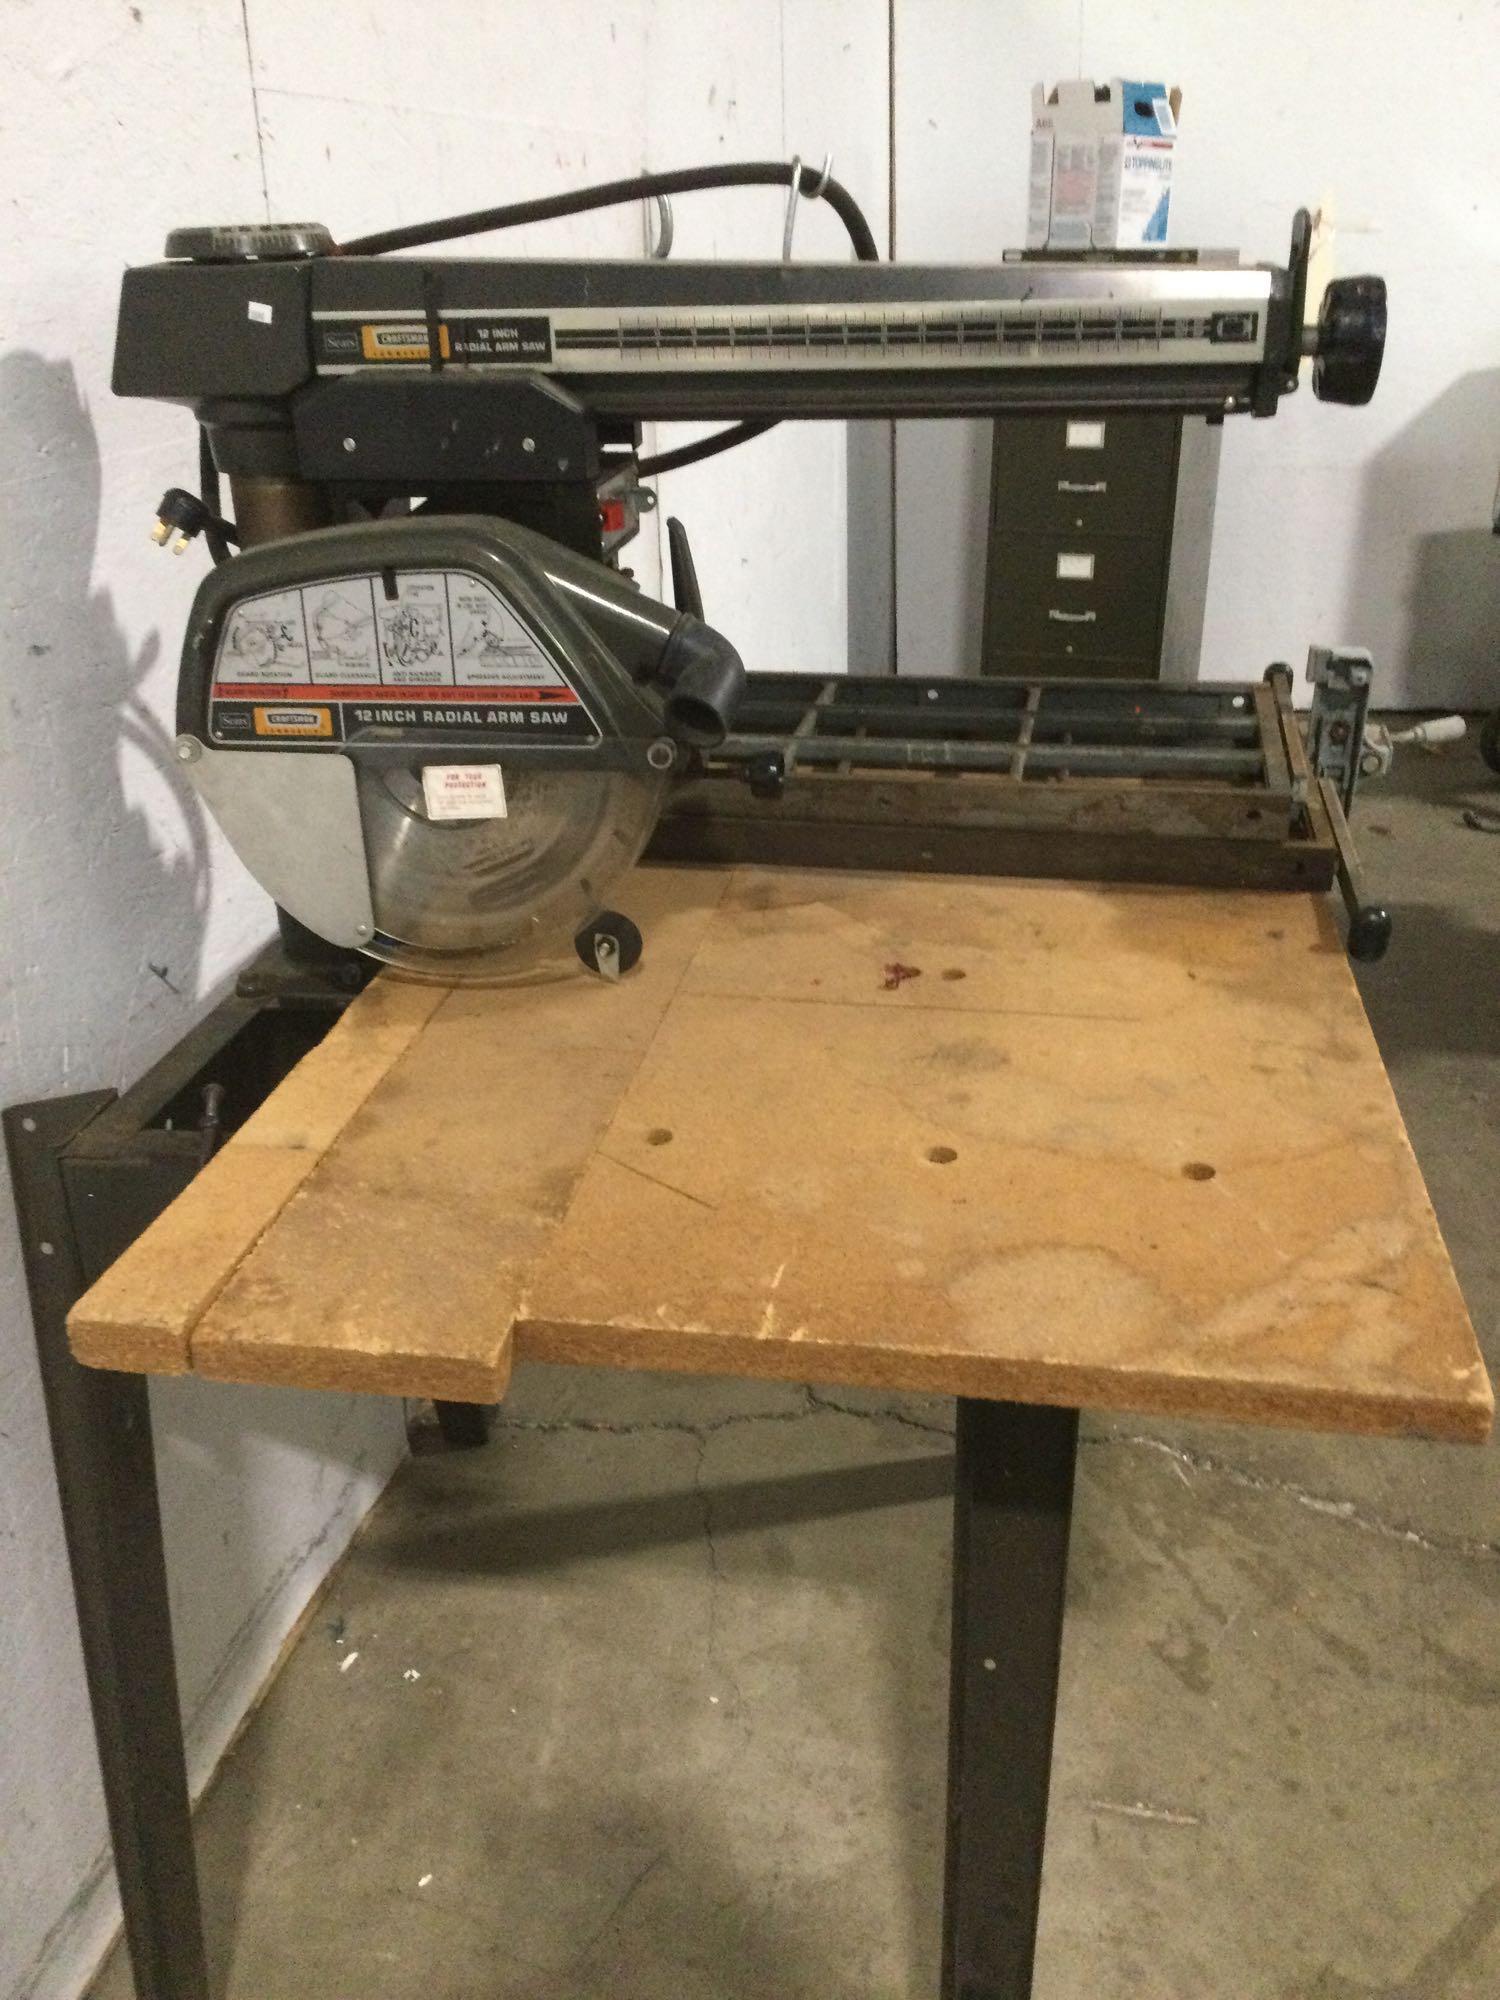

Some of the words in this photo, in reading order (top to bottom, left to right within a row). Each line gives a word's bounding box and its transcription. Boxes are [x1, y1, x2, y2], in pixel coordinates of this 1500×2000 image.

[477, 328, 491, 339] 12
[492, 327, 519, 339] INCH
[494, 341, 519, 352] ARM
[521, 341, 546, 352] SAW
[354, 709, 373, 722] 12
[375, 709, 416, 723] INCH
[423, 710, 482, 723] RADIAL
[486, 710, 525, 724] ARM
[530, 711, 568, 724] SAW
